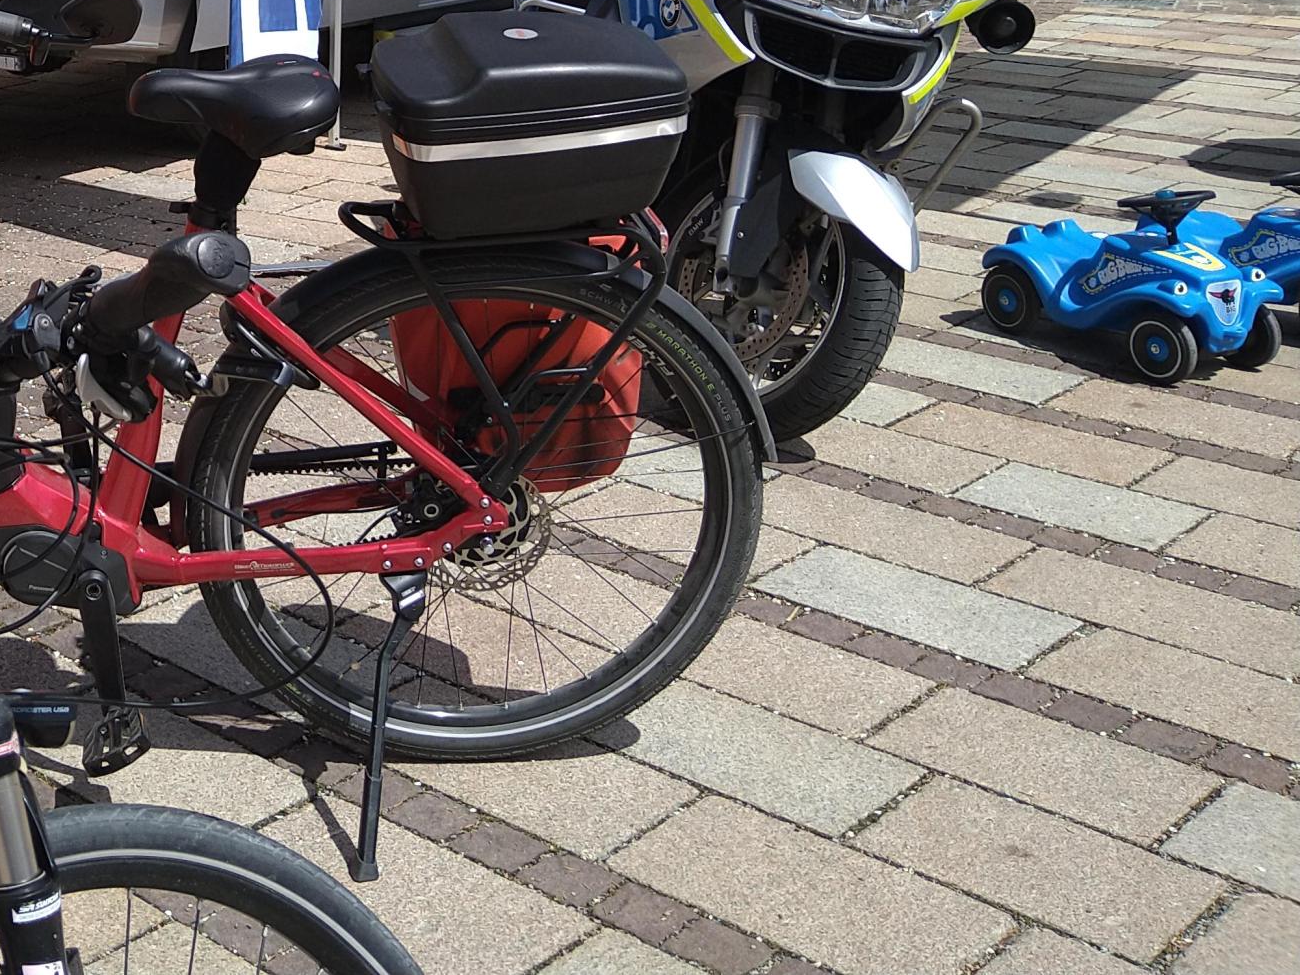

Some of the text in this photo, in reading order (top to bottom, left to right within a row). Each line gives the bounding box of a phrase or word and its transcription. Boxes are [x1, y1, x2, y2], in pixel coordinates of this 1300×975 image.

[656, 330, 732, 423] MARATHON E PLUS
